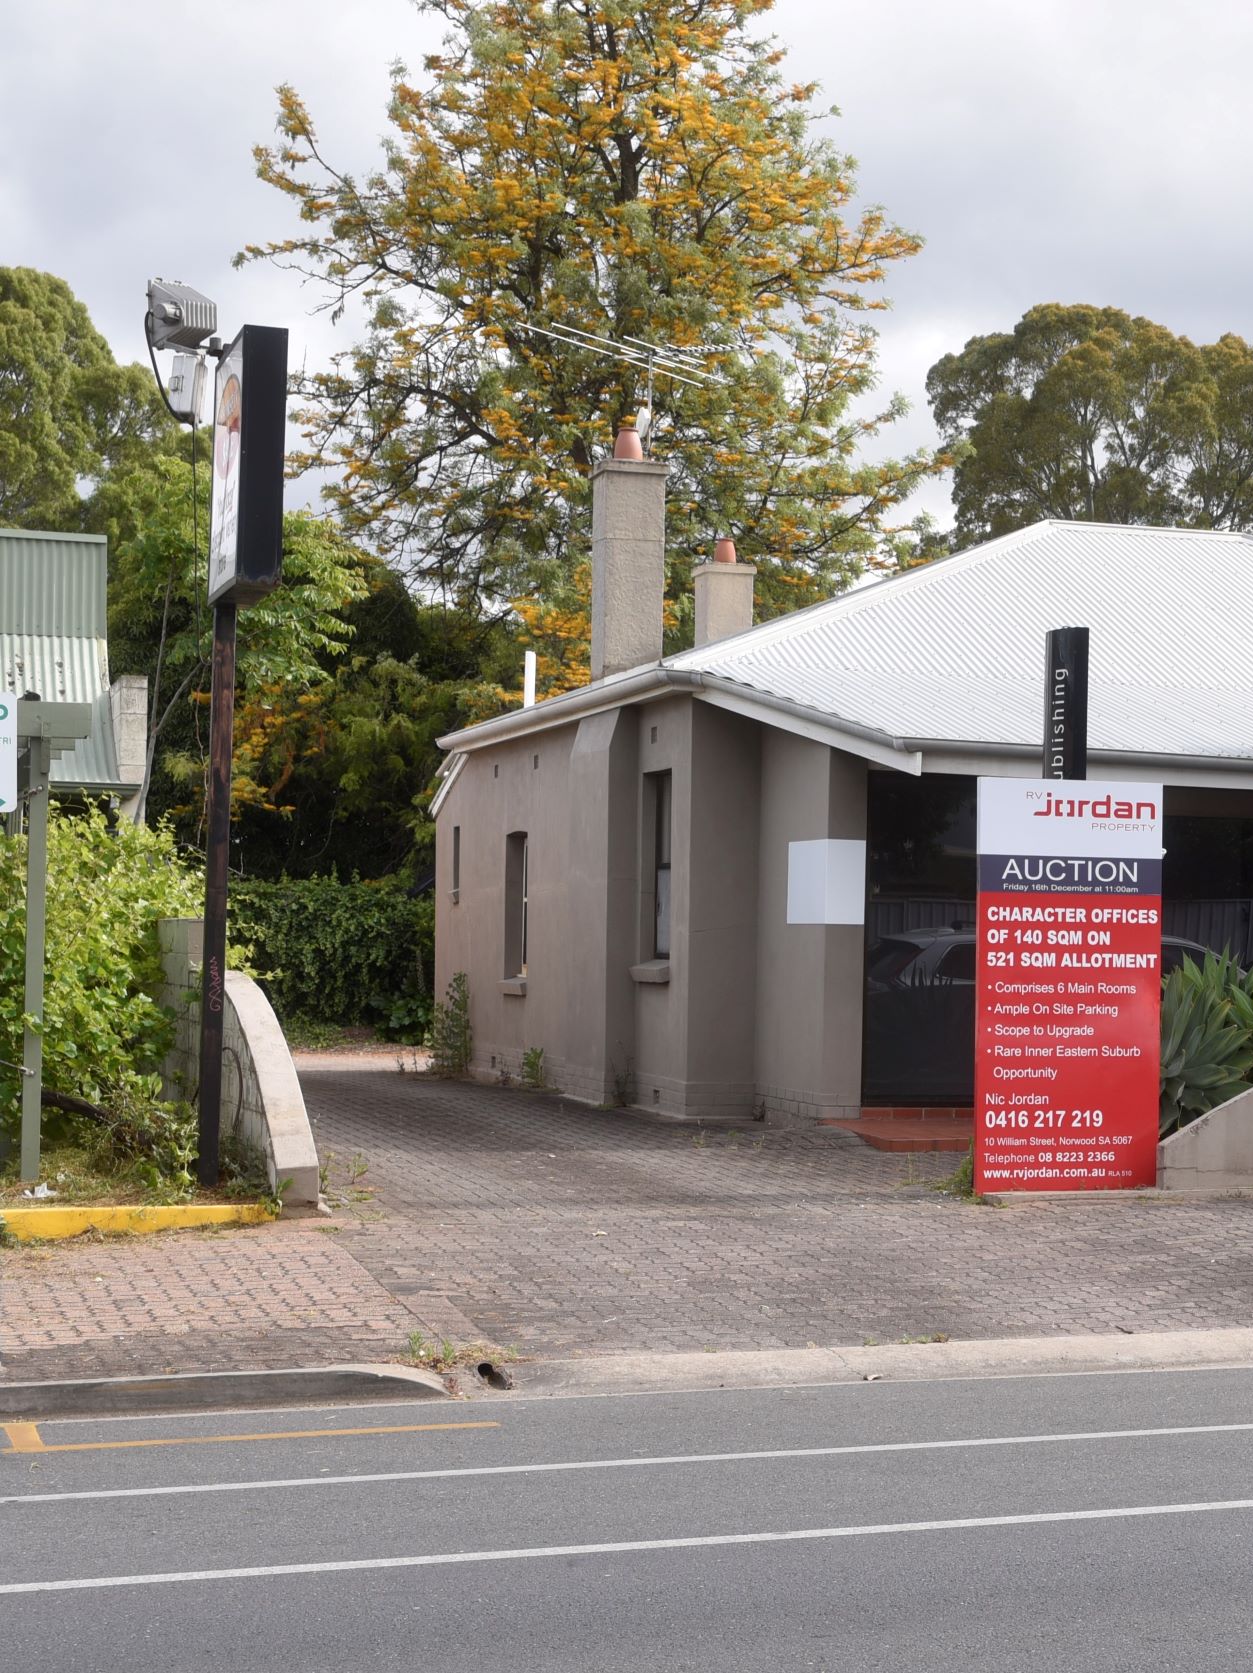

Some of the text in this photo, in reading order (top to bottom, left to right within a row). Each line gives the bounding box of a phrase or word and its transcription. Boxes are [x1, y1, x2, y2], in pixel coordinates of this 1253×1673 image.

[1026, 791, 1043, 800] RV
[1033, 792, 1156, 820] jordan
[1091, 822, 1156, 832] PROPERTY
[1001, 858, 1138, 883] AUCTION
[1003, 883, 1029, 892] Friday
[1050, 884, 1093, 892] December
[1105, 885, 1139, 893] 11:00am
[987, 906, 1158, 924] CHARACTER OFFICES
[987, 929, 1111, 946] OF 140 SQM ON
[987, 951, 1158, 968] 521 SQM ALLOTMENT
[995, 981, 1137, 995] Comprises 6 Main Rooms
[994, 1003, 1119, 1017] Ample On Site Parking
[994, 1024, 1095, 1038] Scope to Upgrade
[994, 1045, 1141, 1057] Rare Inner Eastern Suburb
[993, 1066, 1058, 1080] Opportunity
[985, 1093, 1049, 1105] Nic Jordan
[985, 1109, 1103, 1128] 0416 217 219
[984, 1135, 1133, 1147] 10 William Street, Norwood SA 5067
[984, 1151, 1115, 1165] Telephone 08 8223 2366
[983, 1166, 1106, 1180] www.rvjordan.com.au
